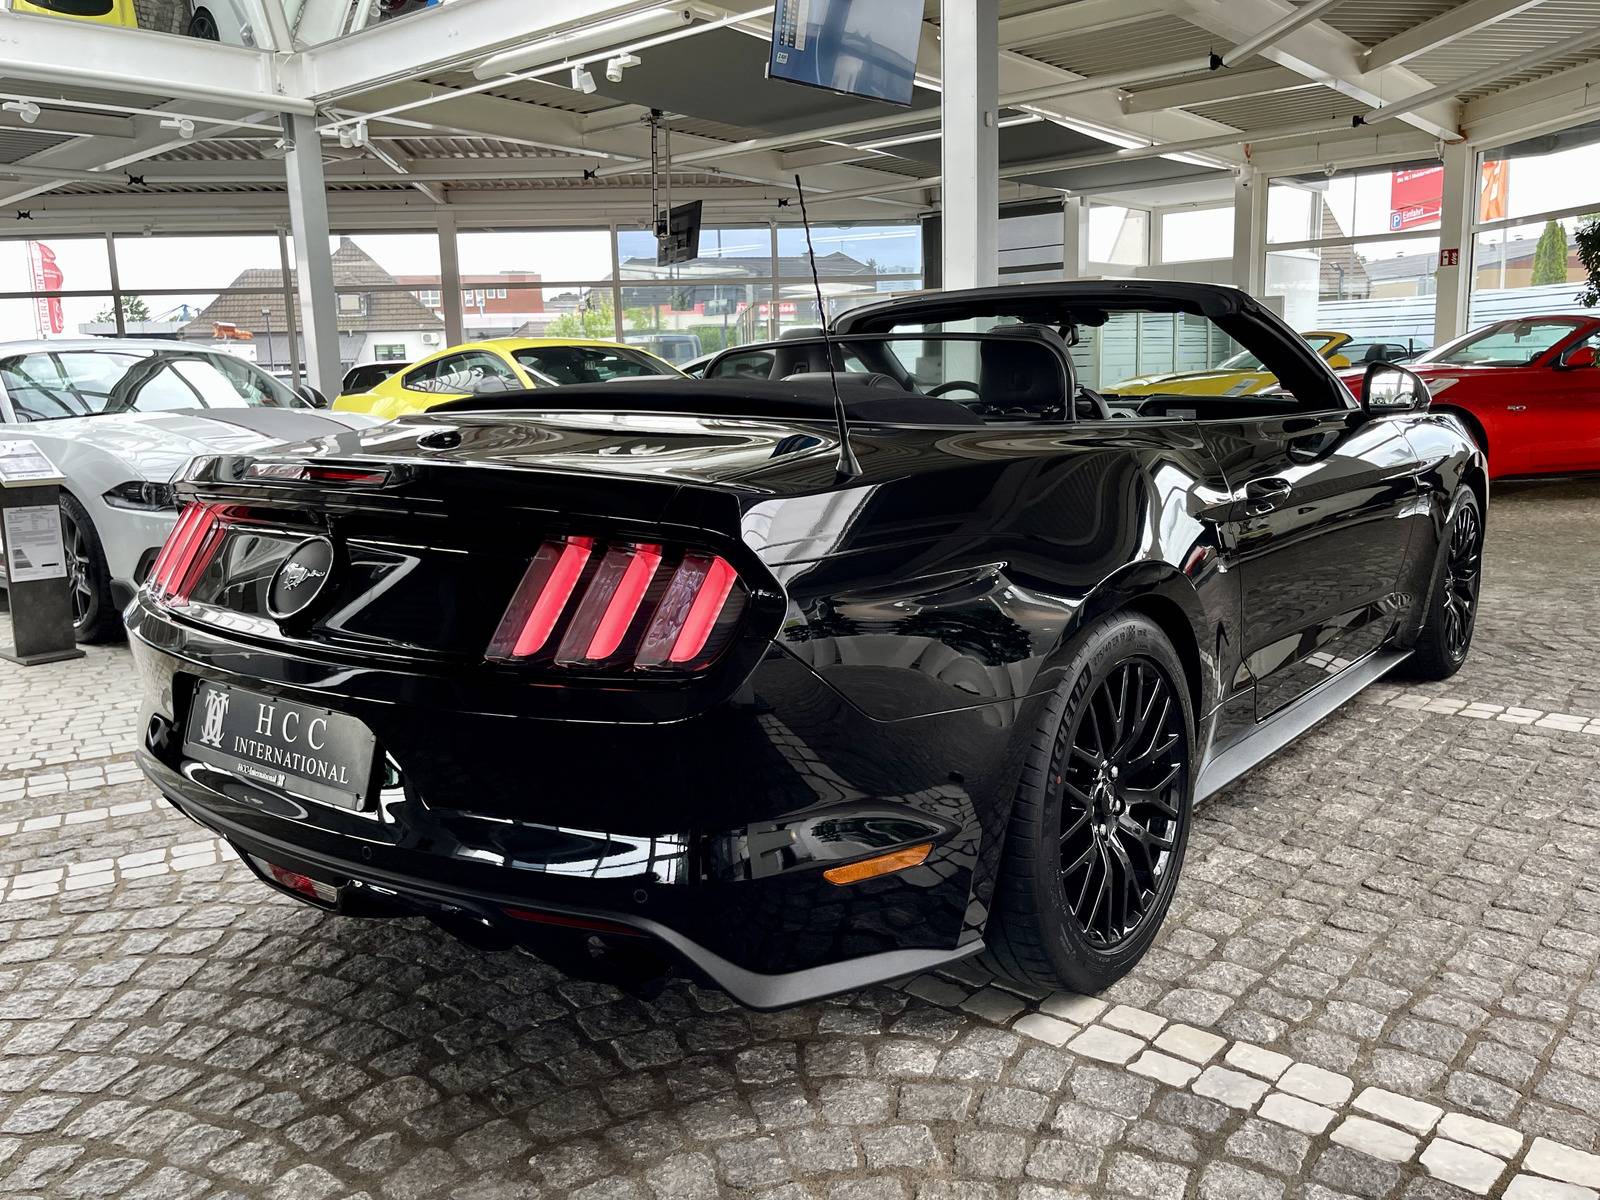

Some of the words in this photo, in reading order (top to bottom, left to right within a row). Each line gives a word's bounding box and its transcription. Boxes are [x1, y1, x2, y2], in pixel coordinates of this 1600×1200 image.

[1402, 208, 1424, 219] Einfahrt
[1048, 670, 1088, 796] MICHELIN
[234, 735, 350, 785] INTERNATIONAL
